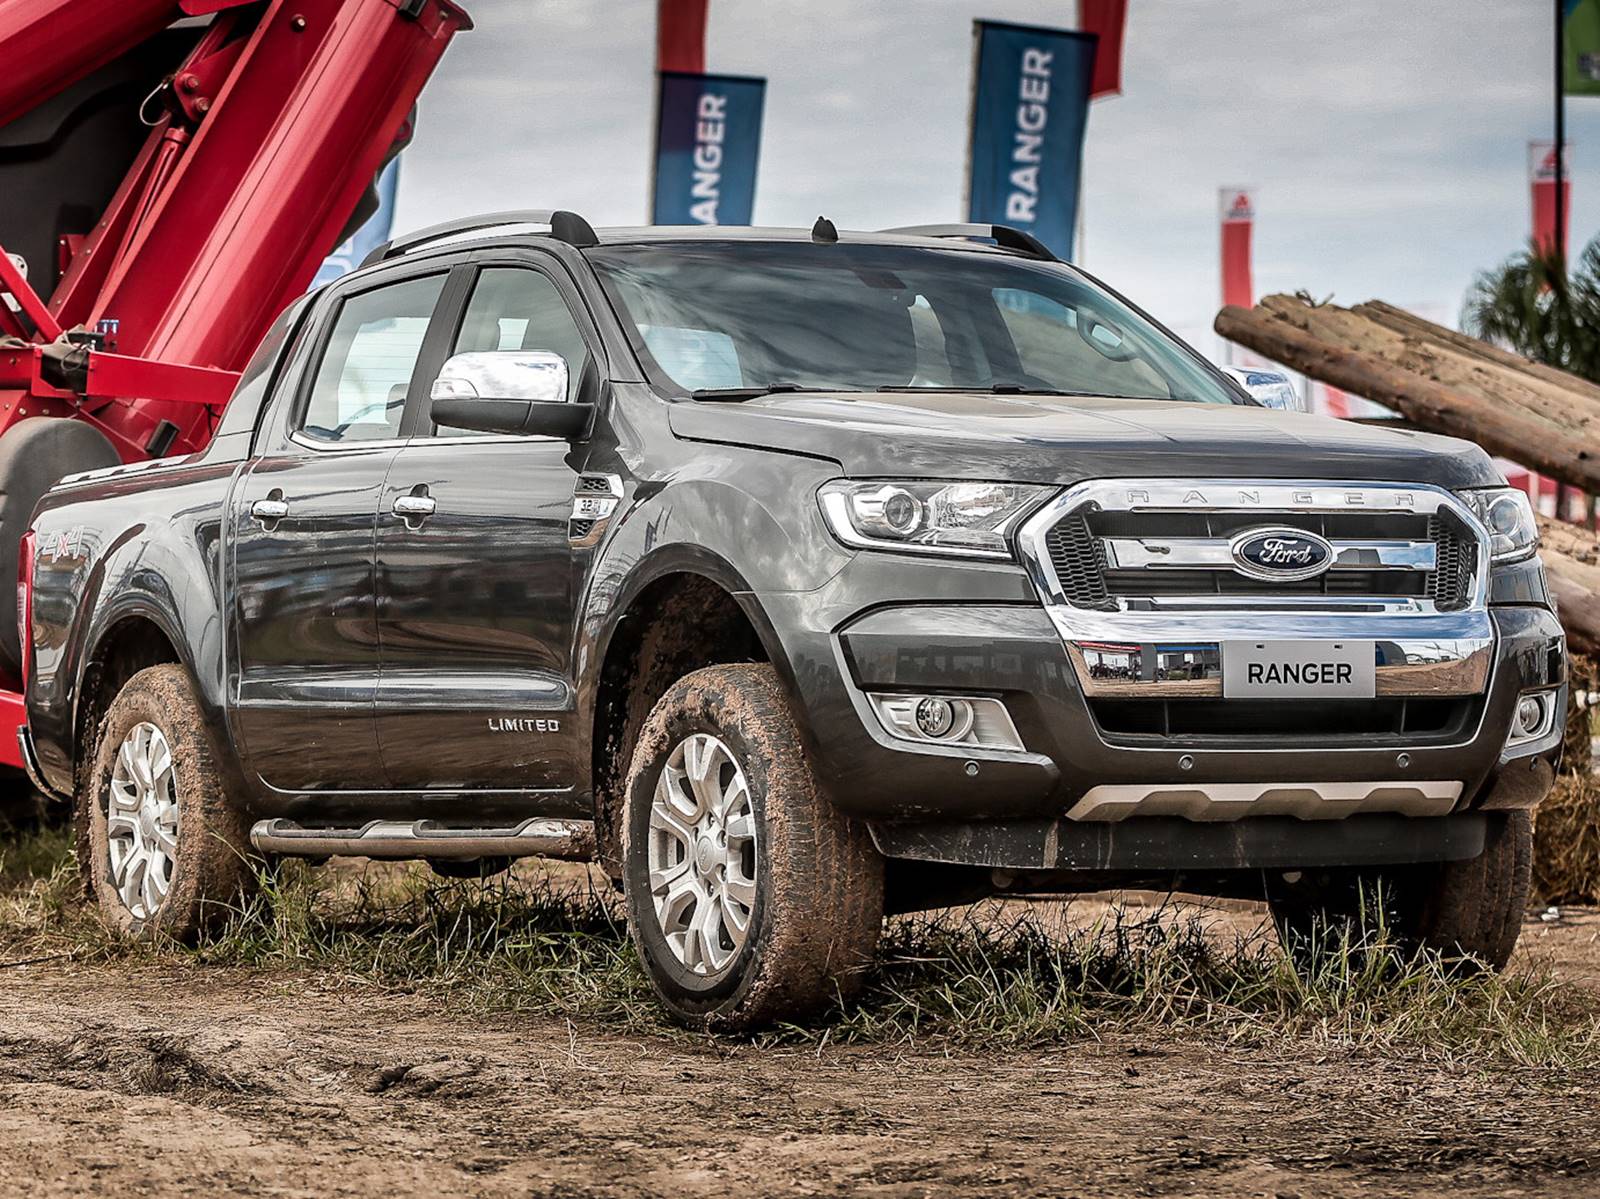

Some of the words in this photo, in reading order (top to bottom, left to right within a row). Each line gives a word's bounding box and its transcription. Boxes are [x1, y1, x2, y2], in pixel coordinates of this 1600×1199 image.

[1005, 48, 1053, 223] RANGER
[1127, 489, 1415, 506] RANGER
[1259, 538, 1312, 563] Ford
[1247, 662, 1353, 684] RANGER
[488, 718, 560, 732] LIMITED
